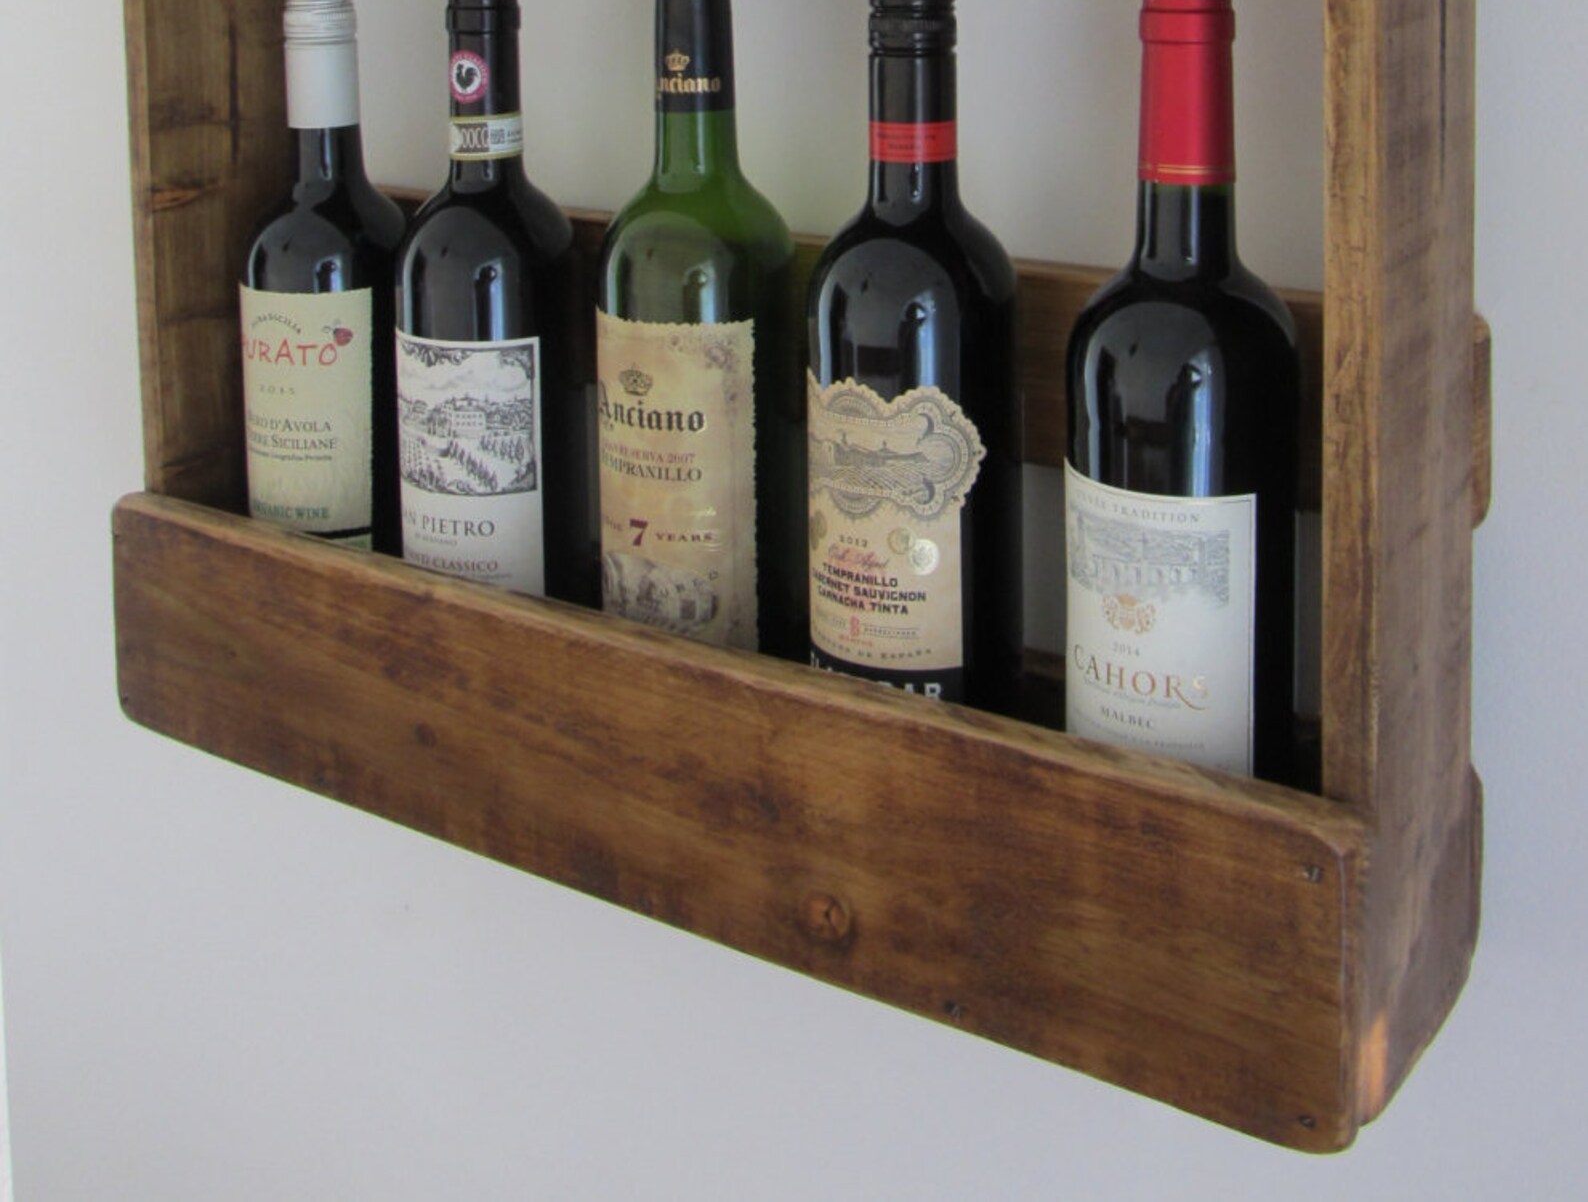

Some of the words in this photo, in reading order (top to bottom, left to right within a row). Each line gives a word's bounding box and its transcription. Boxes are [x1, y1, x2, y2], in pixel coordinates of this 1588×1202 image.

[656, 71, 721, 94] nciano
[244, 338, 338, 367] URATO
[599, 378, 705, 432] Anciano
[271, 434, 338, 450] SICILIANE
[295, 507, 330, 521] WINE
[421, 513, 496, 537] PIETRO
[1113, 503, 1201, 524] TRADITION
[628, 518, 650, 547] 7
[654, 531, 715, 543] YEARS
[822, 561, 899, 588] TEMPRANILLO
[853, 586, 928, 602] SAUVIGNON
[869, 601, 910, 616] TINTA
[1073, 643, 1211, 711] CAHORS
[1100, 703, 1156, 729] MALBEC
